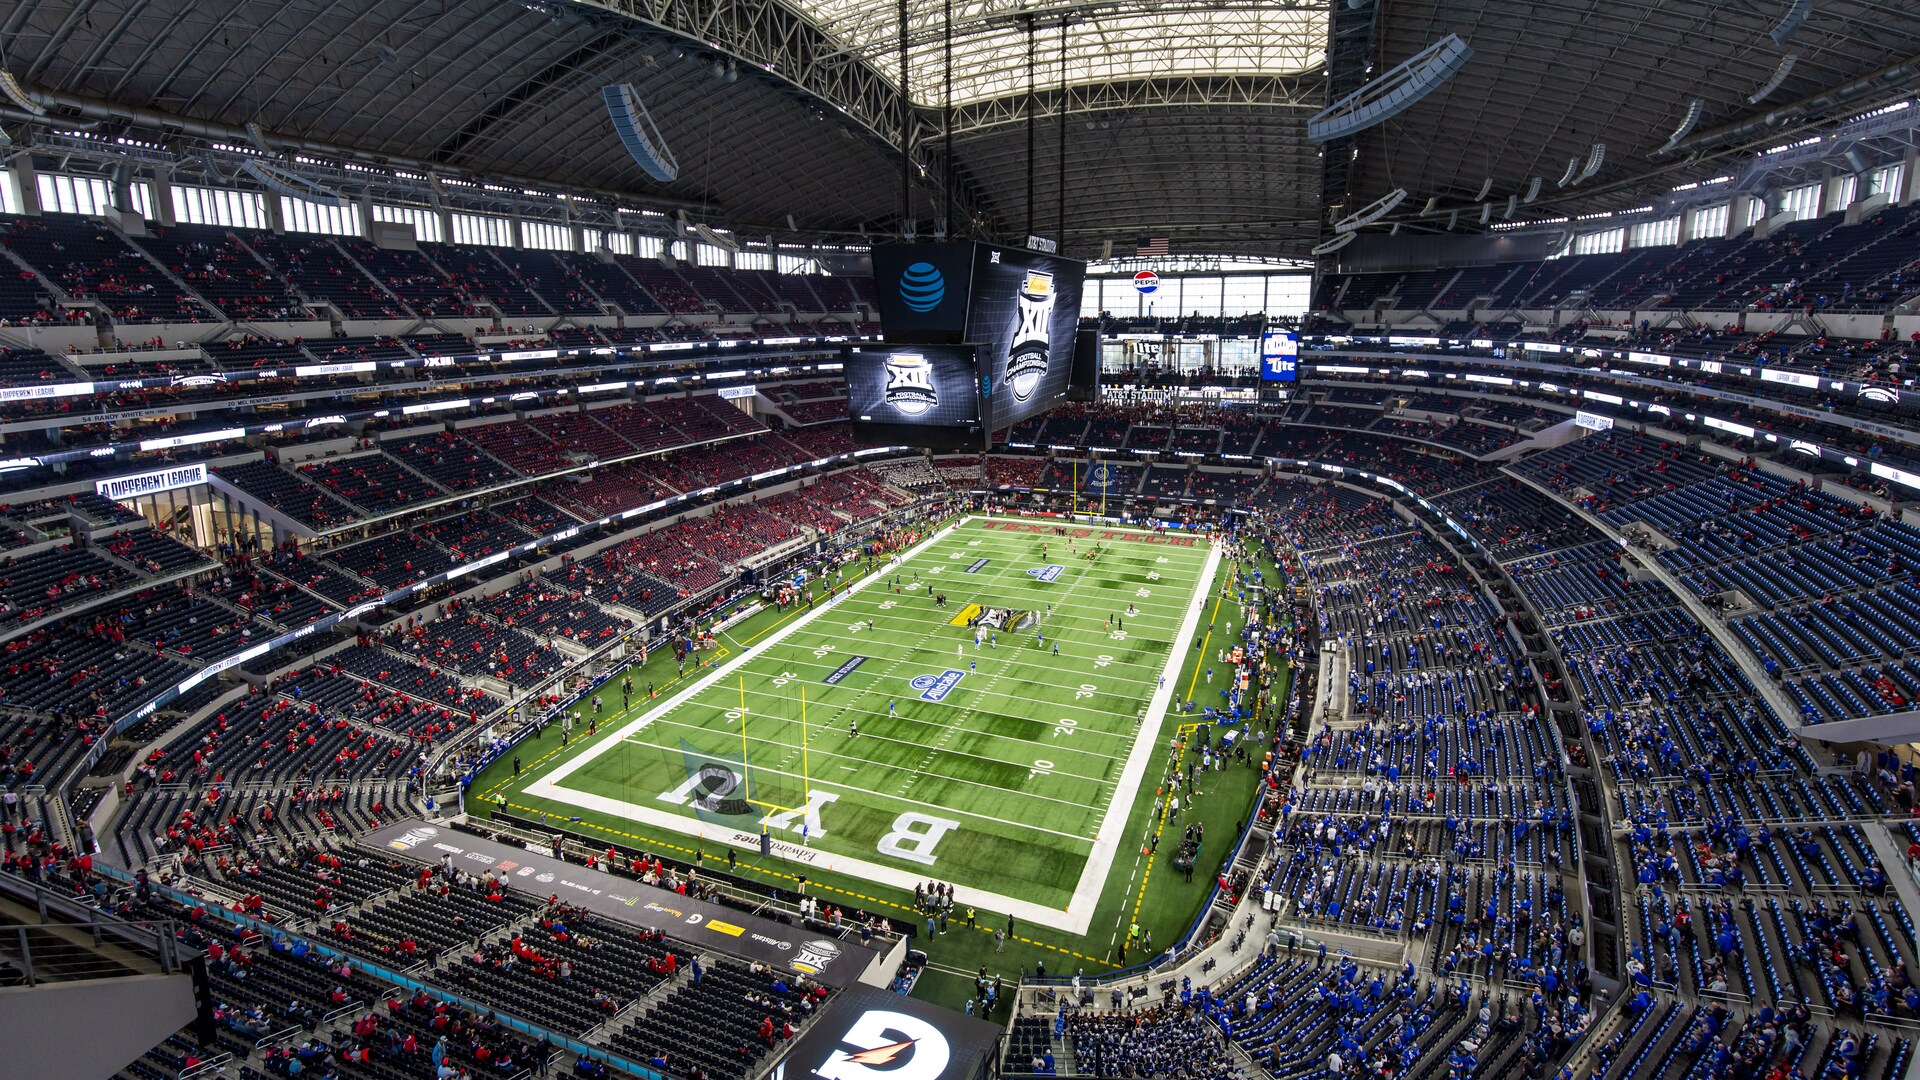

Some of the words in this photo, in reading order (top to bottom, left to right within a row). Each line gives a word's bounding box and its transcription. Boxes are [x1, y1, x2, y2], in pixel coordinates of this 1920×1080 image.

[1132, 342, 1160, 355] Lite
[1016, 352, 1042, 364] FOOTBALL
[1006, 359, 1047, 377] CHAMPIONSHIP
[1271, 360, 1296, 374] Lite
[3, 389, 34, 399] DIFFERENT
[34, 387, 56, 397] LEAGUE
[1107, 391, 1129, 400] AT&T
[1131, 391, 1172, 401] STADIUM
[249, 397, 271, 405] RENFRO
[94, 413, 119, 422] RANDY
[121, 410, 143, 419] WHITE
[1858, 421, 1875, 432] EMMITT
[1875, 424, 1889, 435] SMITH
[111, 473, 165, 497] DIFFERENT
[167, 467, 202, 493] LEAGUE
[984, 521, 1094, 538] TEXAS
[1100, 531, 1200, 547] TECH
[813, 644, 836, 656] 30
[1097, 654, 1114, 668] 40
[772, 671, 798, 686] 20
[927, 672, 960, 701] Allstate
[1078, 684, 1097, 698] 30
[724, 706, 749, 720] 10
[1056, 718, 1078, 735] 20
[1032, 759, 1054, 775] 10
[656, 769, 961, 866] BYU
[733, 833, 817, 862] Edwardnes
[685, 913, 703, 924] G
[751, 933, 780, 946] Allstate
[792, 948, 833, 970] XII
